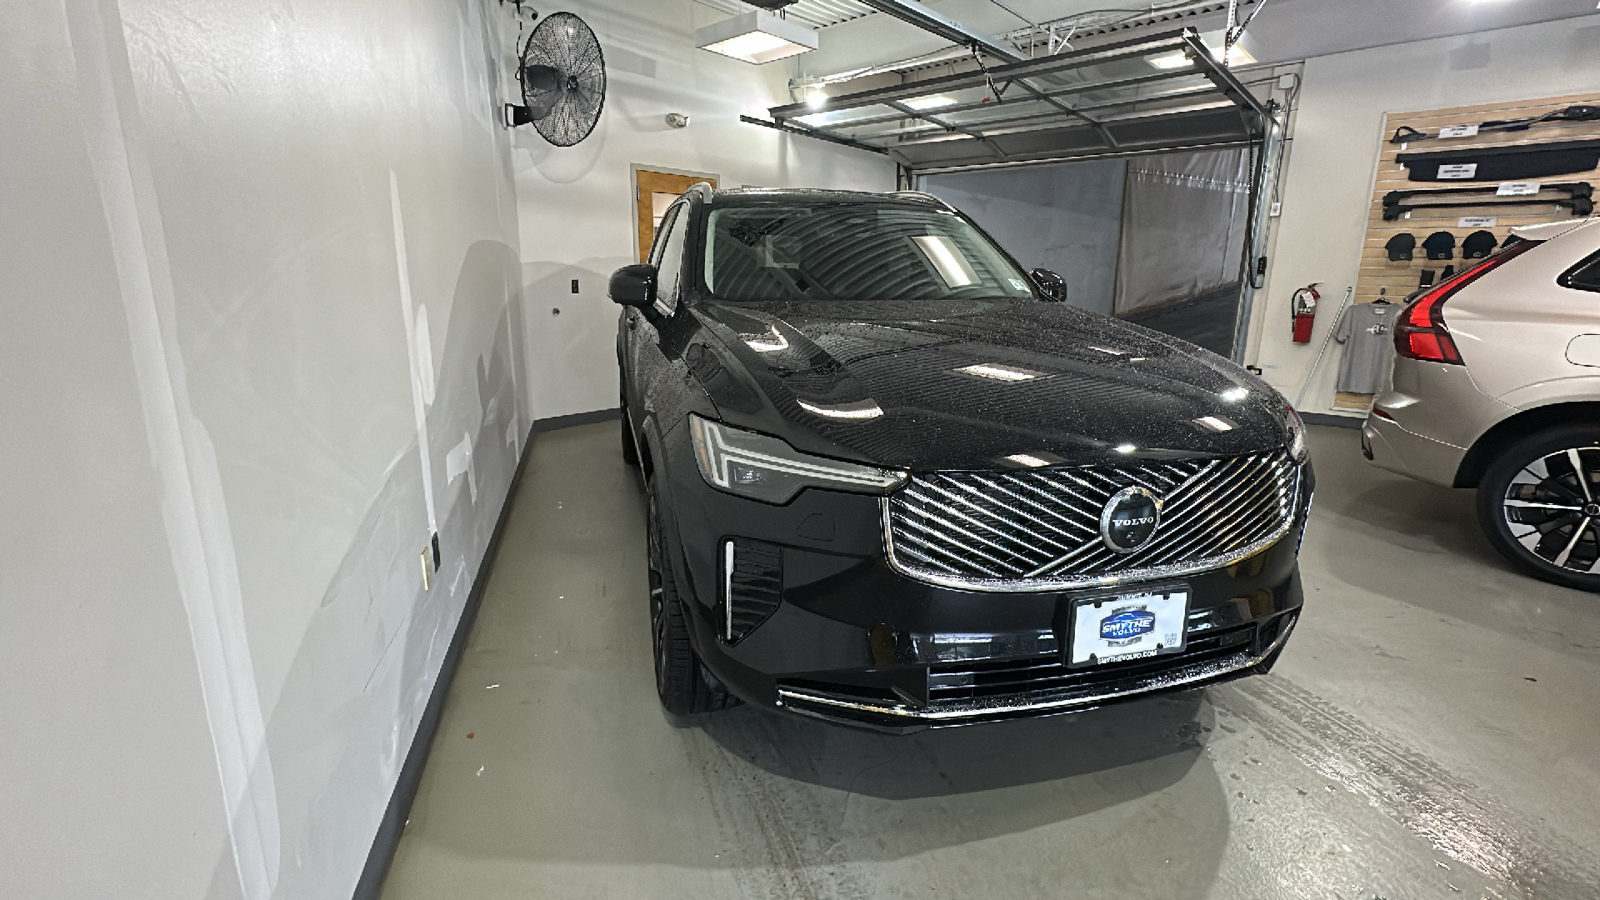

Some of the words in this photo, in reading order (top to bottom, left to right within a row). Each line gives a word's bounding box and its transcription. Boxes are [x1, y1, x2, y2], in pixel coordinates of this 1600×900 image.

[1112, 516, 1154, 527] VOLVO
[1101, 619, 1151, 633] SMYTHE
[1112, 627, 1141, 636] VOLVO
[1097, 649, 1158, 665] SMYTHEVOLVO.COM
